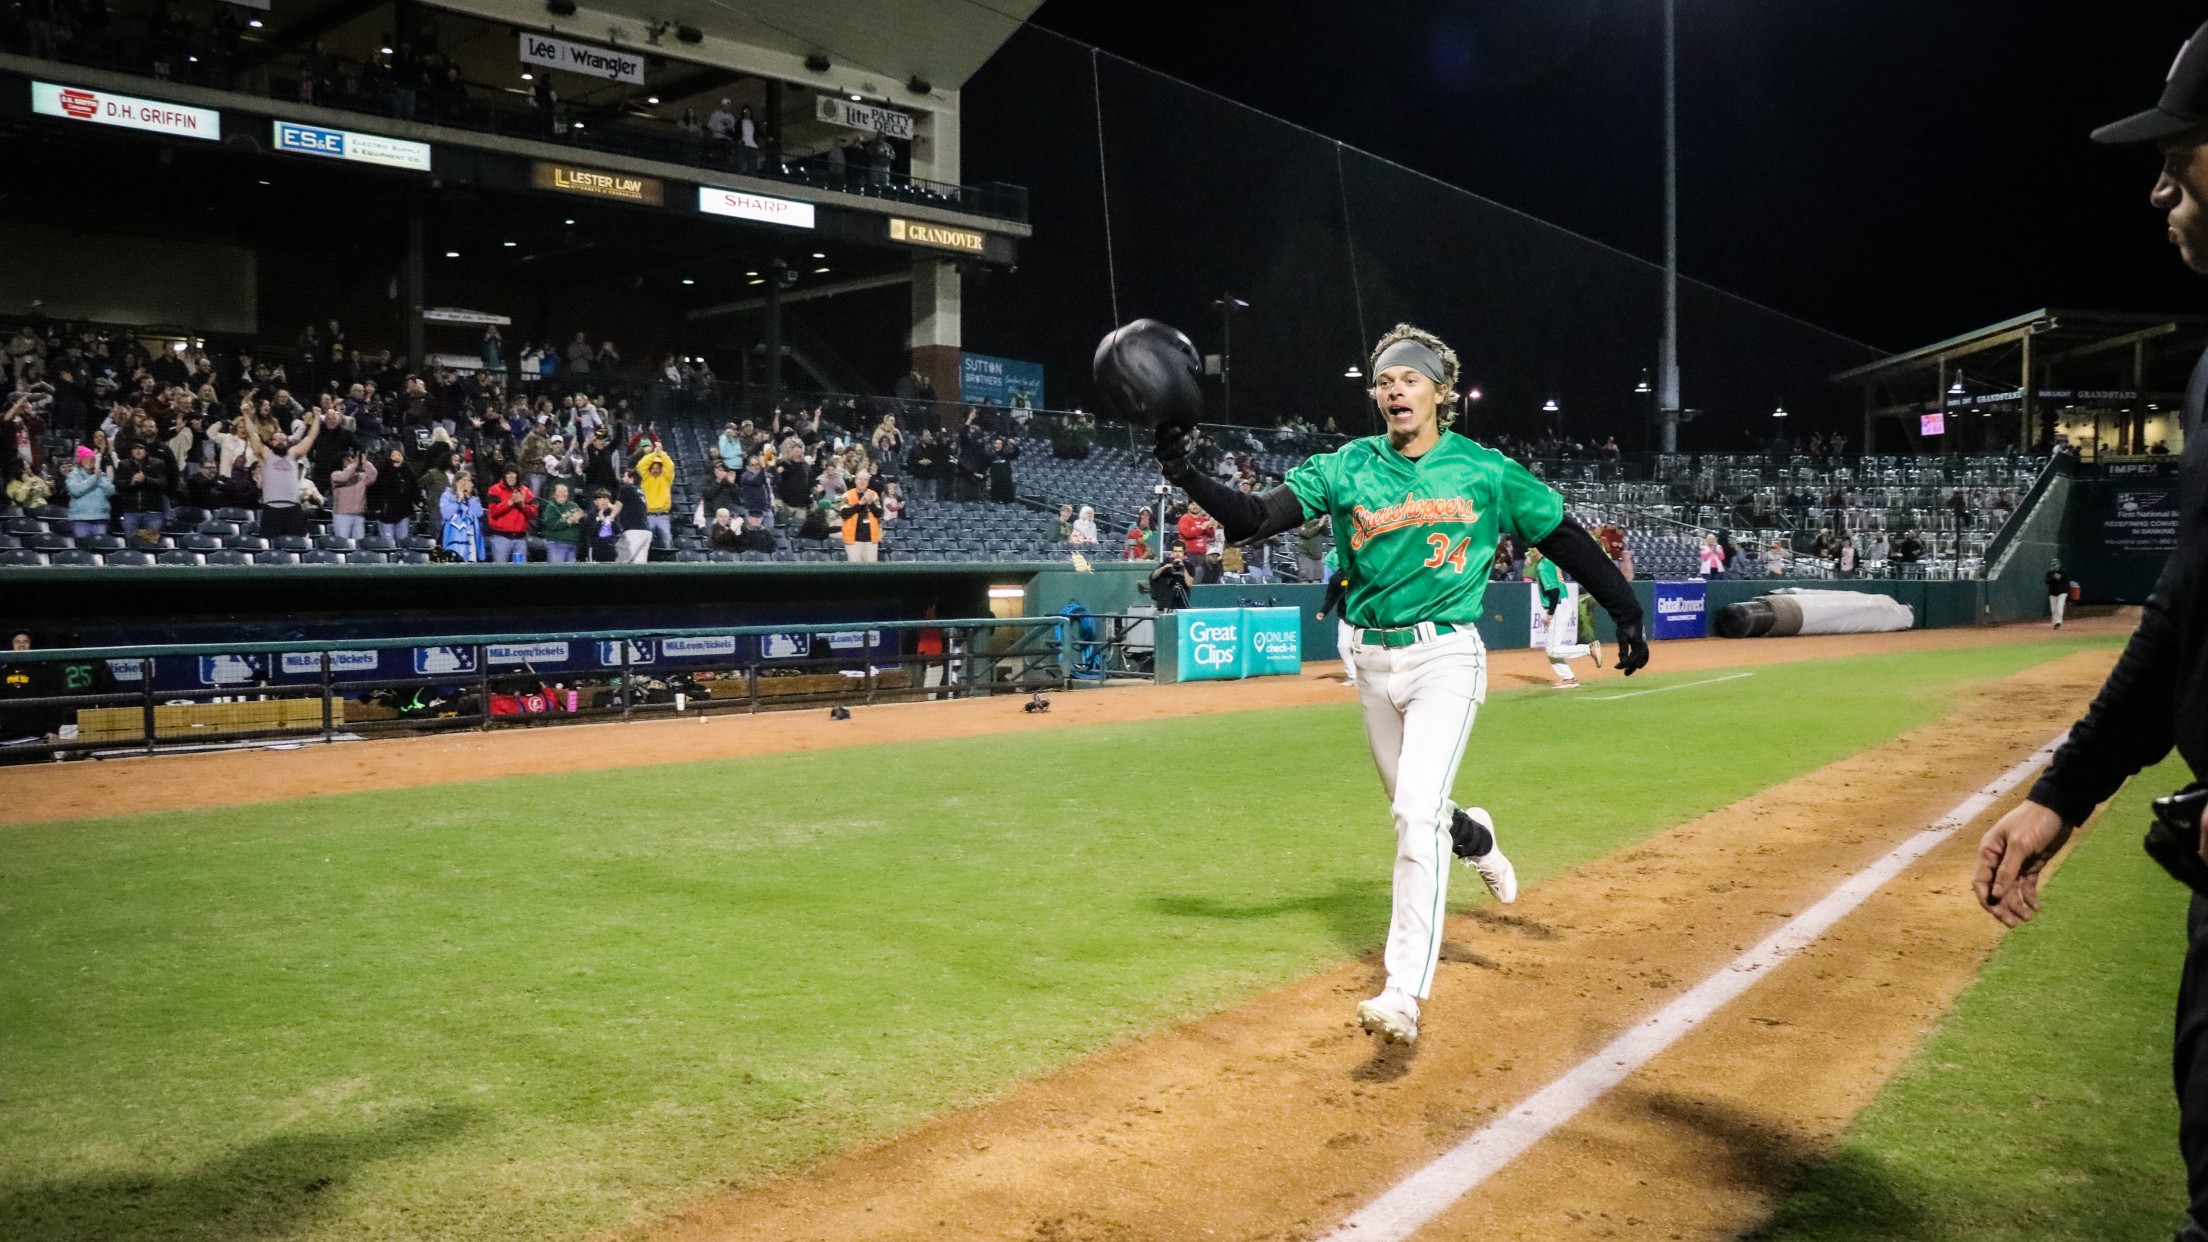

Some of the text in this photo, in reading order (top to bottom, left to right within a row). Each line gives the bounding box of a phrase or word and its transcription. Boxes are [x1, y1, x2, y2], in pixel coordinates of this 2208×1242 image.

[528, 38, 637, 78] Lee Wrangler
[107, 102, 197, 130] D.H. GRIFFIN
[846, 105, 909, 126] Lite PARTY
[874, 119, 908, 137] DECK
[284, 128, 342, 152] ES&E
[569, 170, 642, 193] LESTER LAW
[725, 194, 788, 213] SHARP
[909, 225, 983, 250] GRANDOVER
[965, 358, 1003, 375] SUTTON
[965, 373, 1003, 387] BROTHERS
[2109, 465, 2158, 474] IMPEX
[1351, 492, 1475, 550] Grasshoppers
[1424, 533, 1472, 574] 34
[1190, 621, 1238, 643] Great
[1265, 631, 1297, 643] ONLINE
[489, 646, 565, 658] MiLB.com/tickets
[665, 640, 732, 651] MiLB.com/tickets
[1266, 643, 1297, 653] check-in
[286, 653, 373, 667] MiLB.c/tickets
[1194, 644, 1234, 670] Clips
[65, 663, 93, 689] 25
